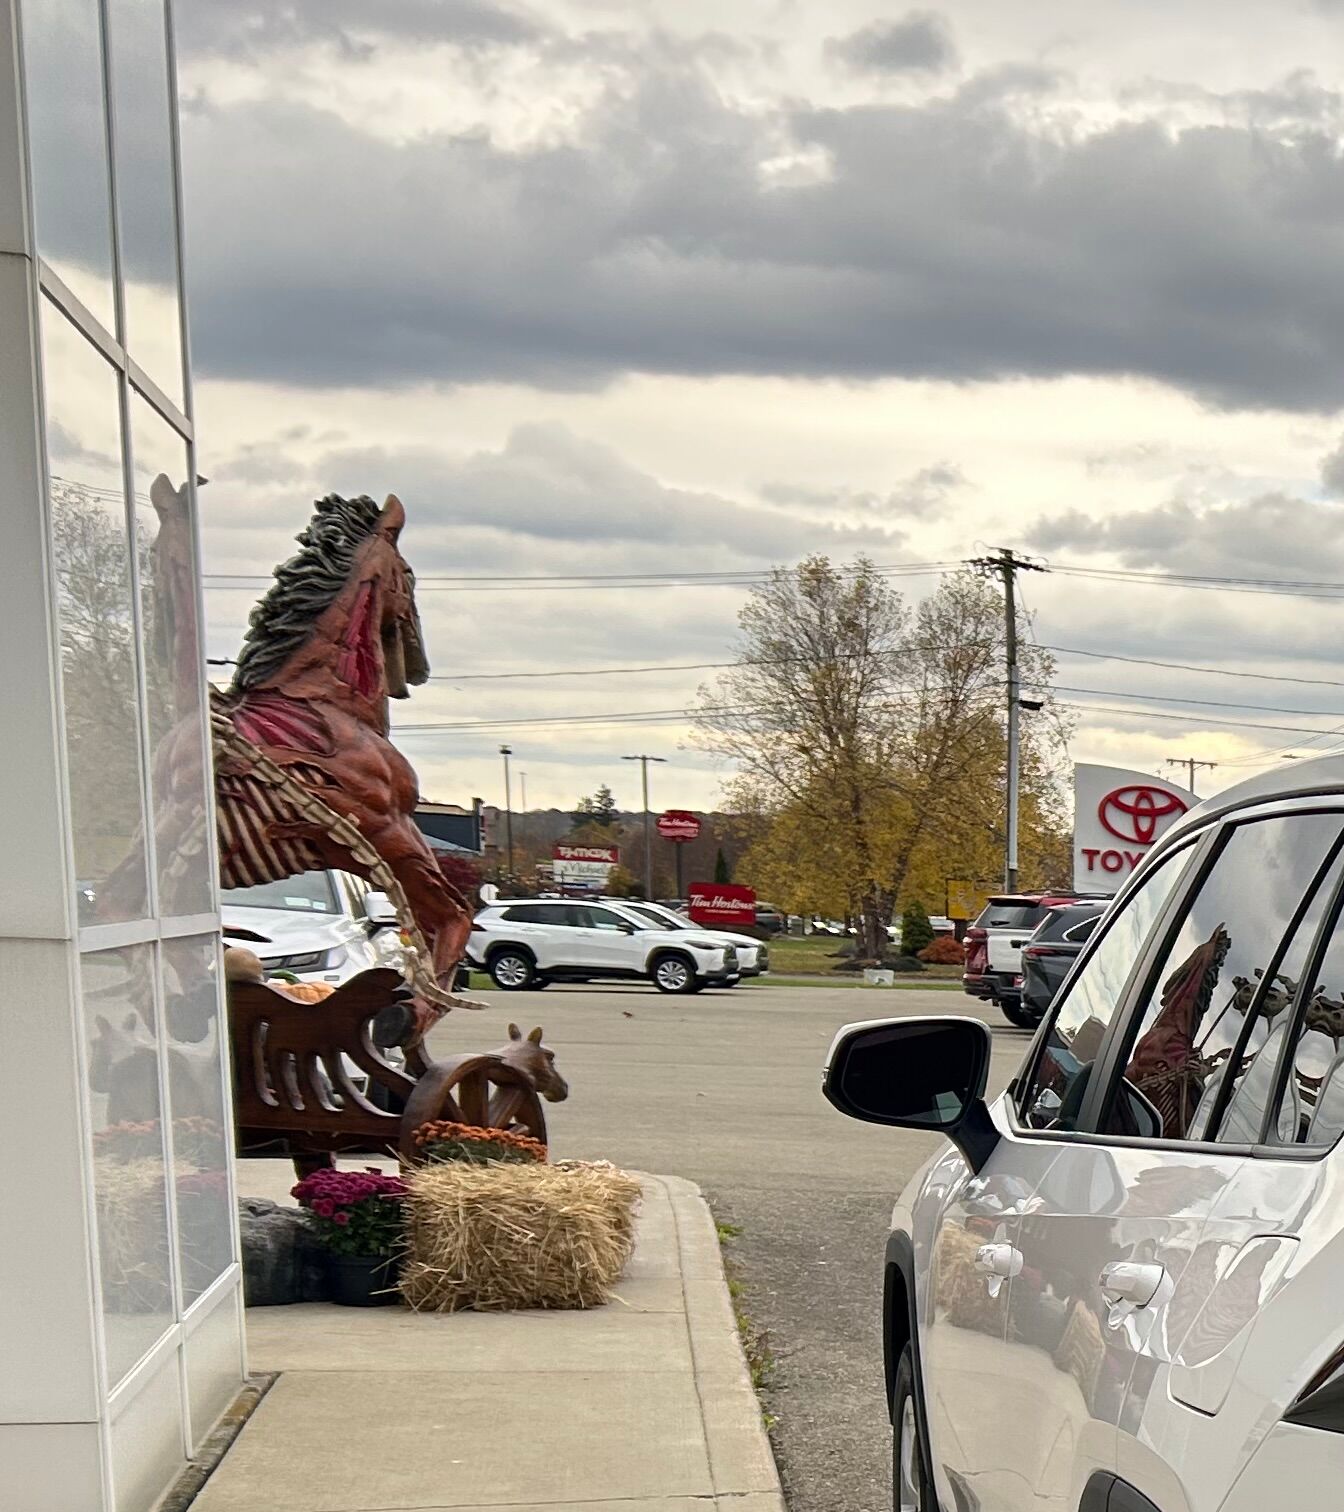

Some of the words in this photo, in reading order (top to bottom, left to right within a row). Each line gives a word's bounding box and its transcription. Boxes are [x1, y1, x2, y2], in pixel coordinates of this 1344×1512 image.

[1081, 848, 1146, 873] TOY
[690, 894, 711, 908] Tim
[711, 895, 754, 910] Hortons
